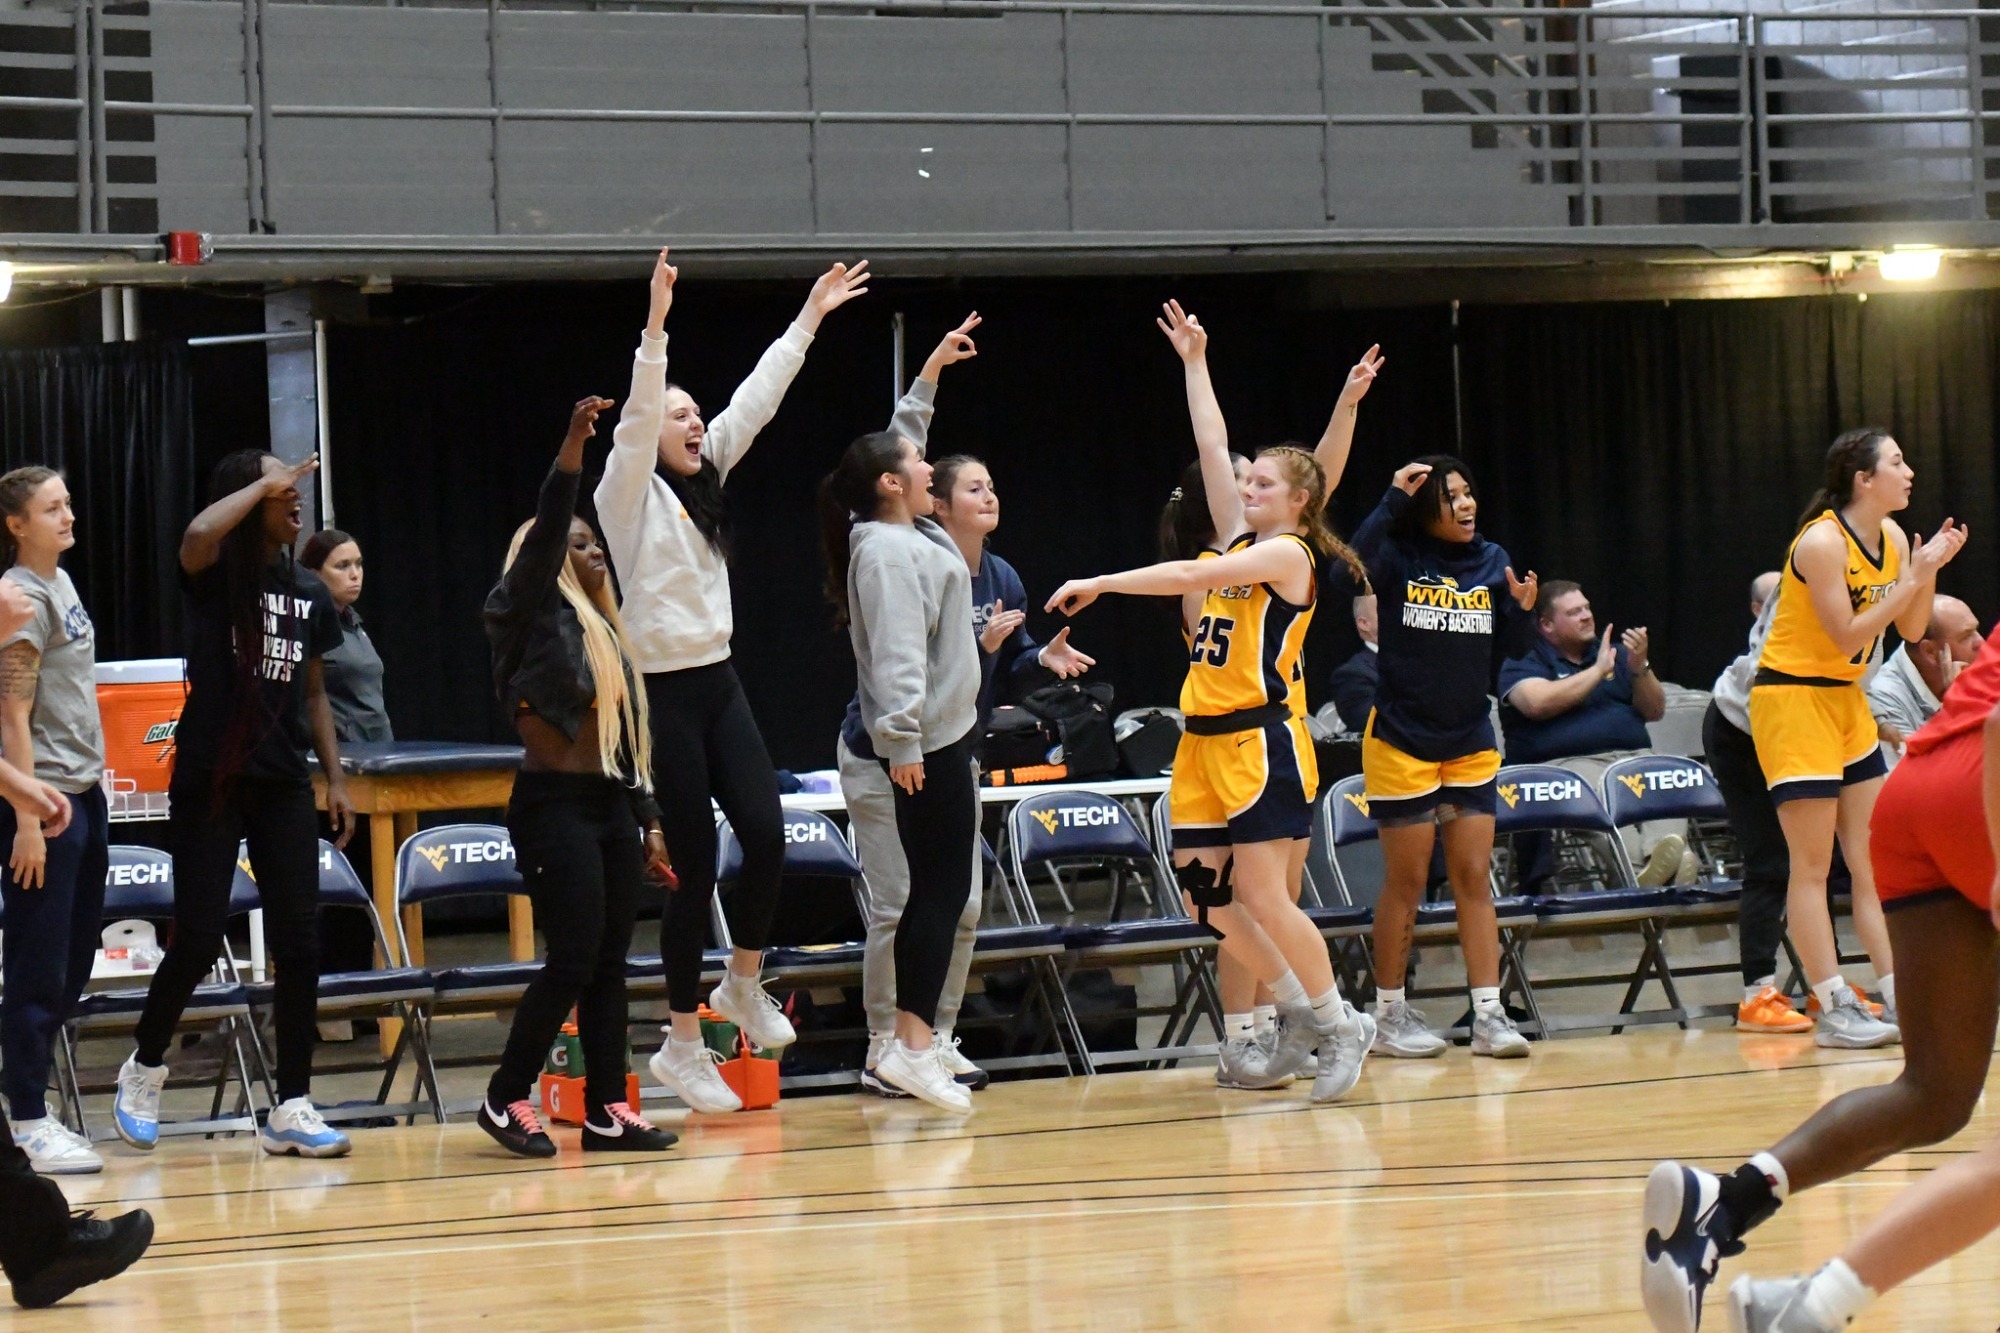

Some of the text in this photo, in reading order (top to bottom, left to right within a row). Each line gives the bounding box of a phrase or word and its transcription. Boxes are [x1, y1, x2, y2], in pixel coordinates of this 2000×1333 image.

[1402, 606, 1447, 632] WOMEN'S
[1189, 615, 1236, 669] 25
[1519, 780, 1582, 802] TECH
[1644, 768, 1704, 791] TECH
[1058, 805, 1120, 827] TECH
[783, 822, 826, 844] ECH
[449, 840, 516, 863] TECH
